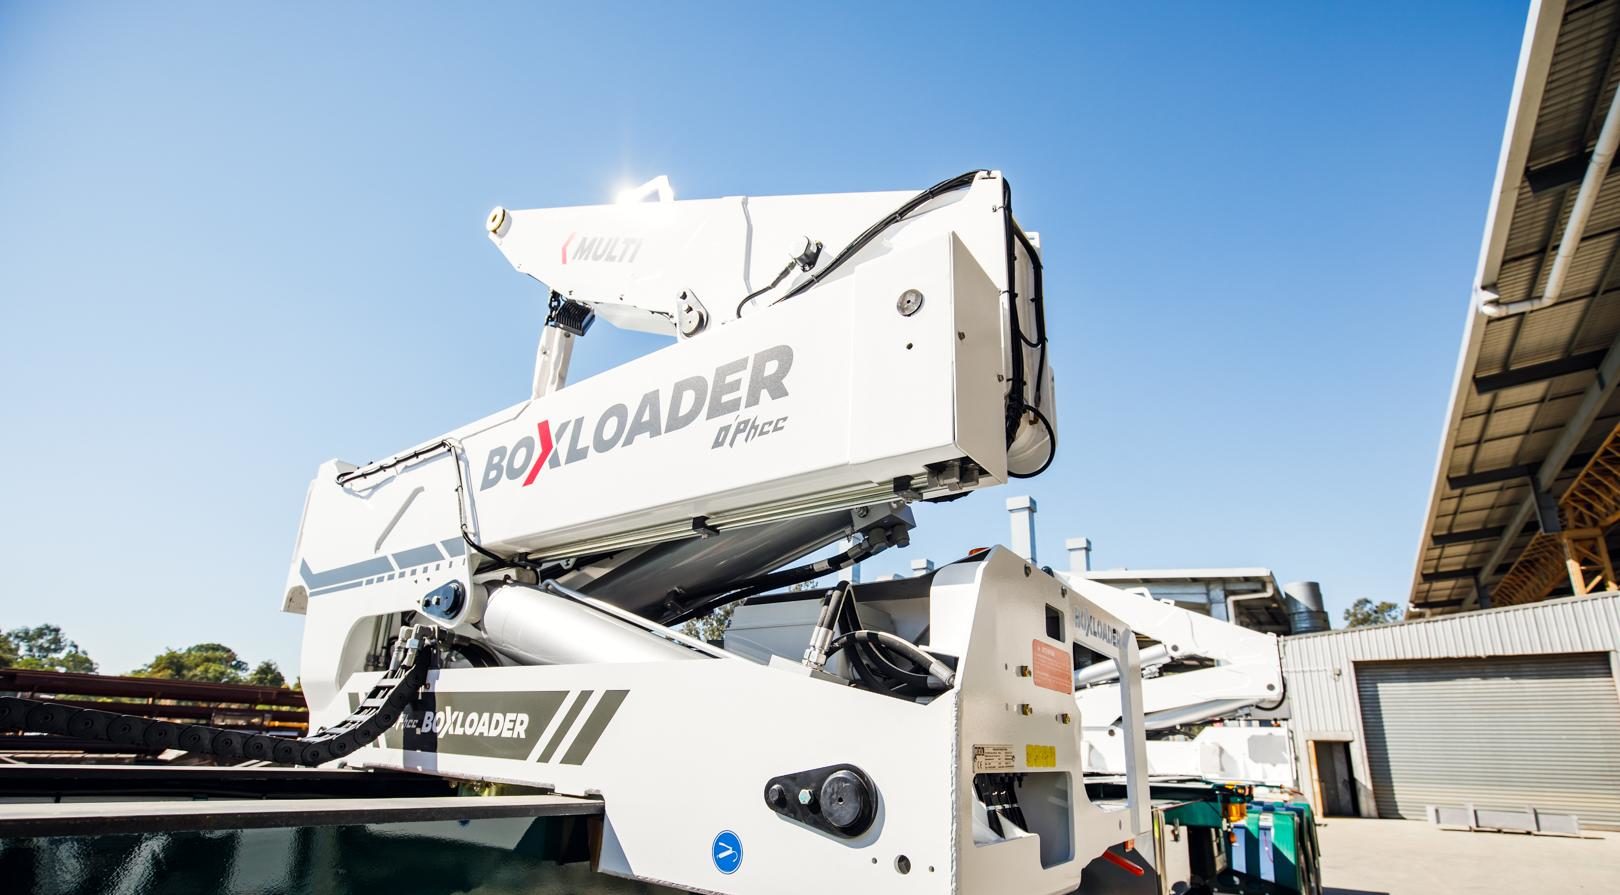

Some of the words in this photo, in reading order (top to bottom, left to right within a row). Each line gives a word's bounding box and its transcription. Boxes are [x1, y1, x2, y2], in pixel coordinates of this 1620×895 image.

[573, 236, 642, 263] MULTI
[480, 344, 794, 491] BOXLOADER
[421, 706, 529, 738] BOXLOADER
